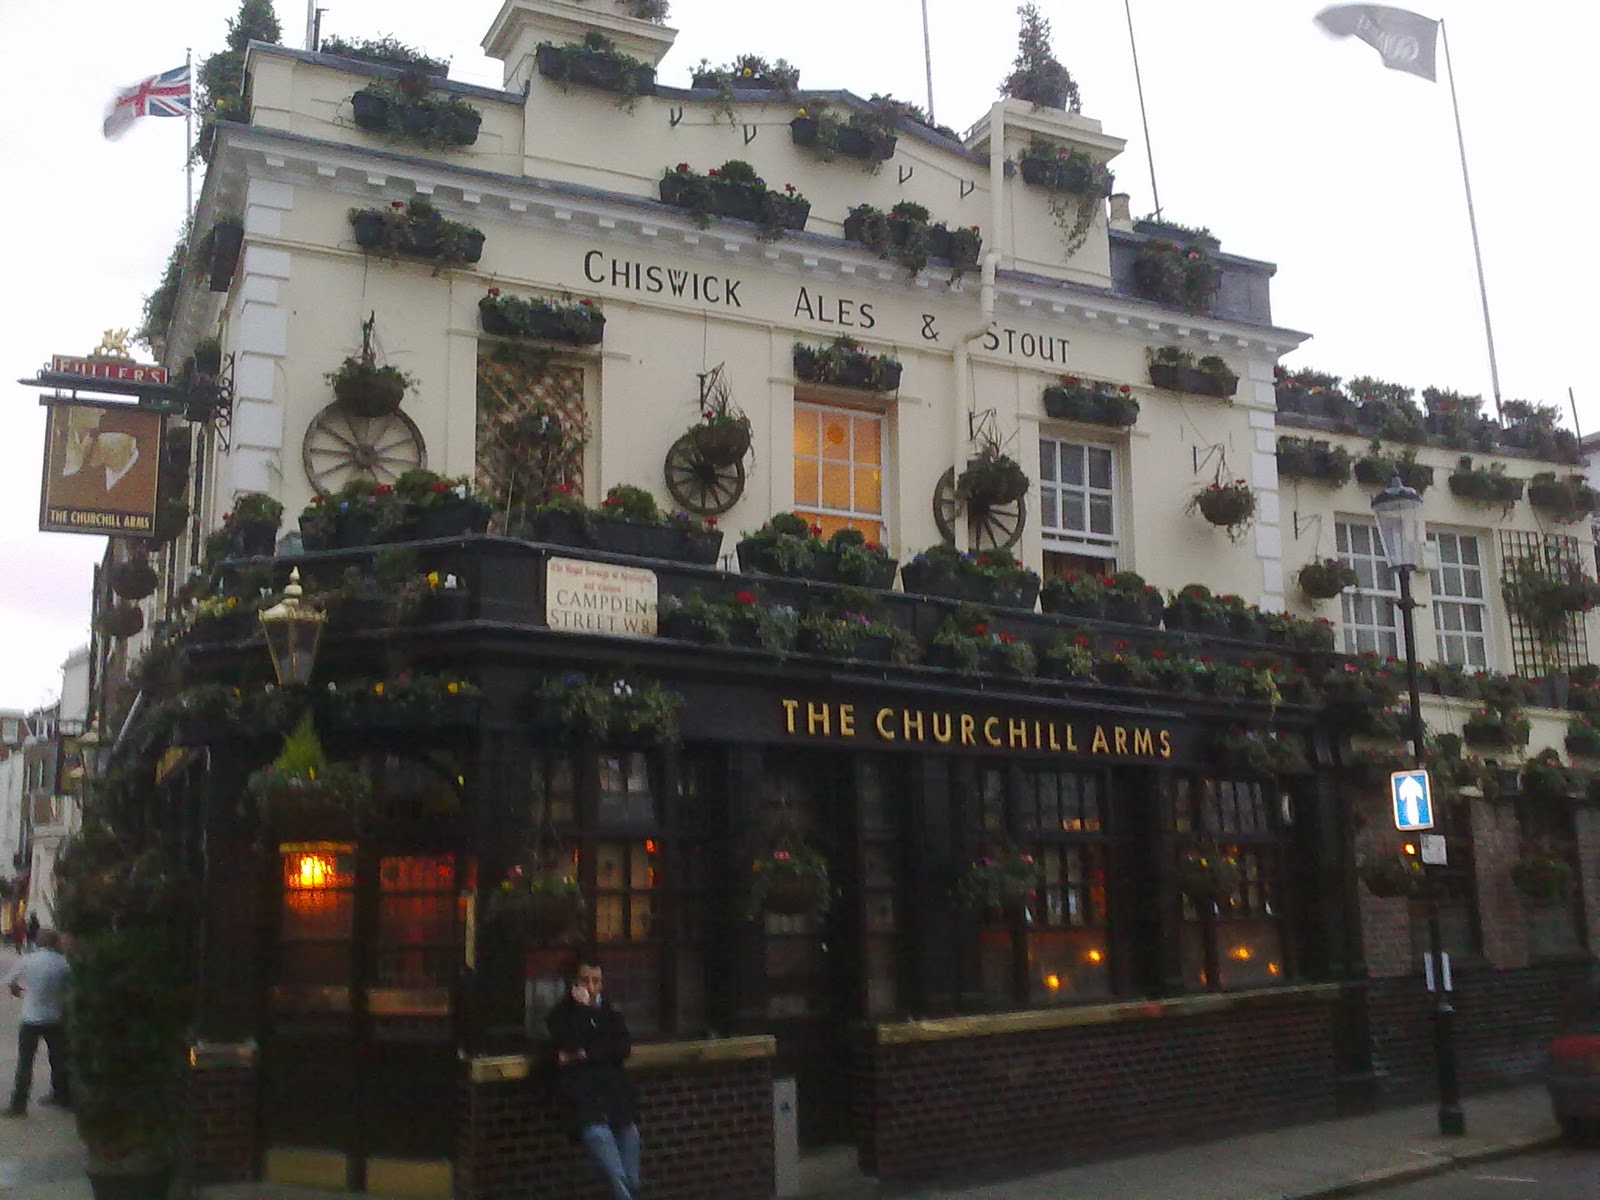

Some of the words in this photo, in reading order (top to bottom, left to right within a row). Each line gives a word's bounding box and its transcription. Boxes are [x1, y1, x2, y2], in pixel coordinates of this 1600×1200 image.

[584, 250, 742, 307] CHISWICK
[794, 287, 876, 329] ALES
[921, 313, 940, 342] &
[983, 321, 1070, 364] STOUT
[51, 510, 67, 522] THE
[71, 511, 121, 527] CHURCHILL
[124, 515, 150, 528] ARMS
[557, 589, 647, 614] CAMPDEN
[551, 608, 614, 631] STREET
[782, 699, 855, 736] THE
[876, 707, 1077, 752] CHURCHILL
[1091, 724, 1172, 758] ARMS
